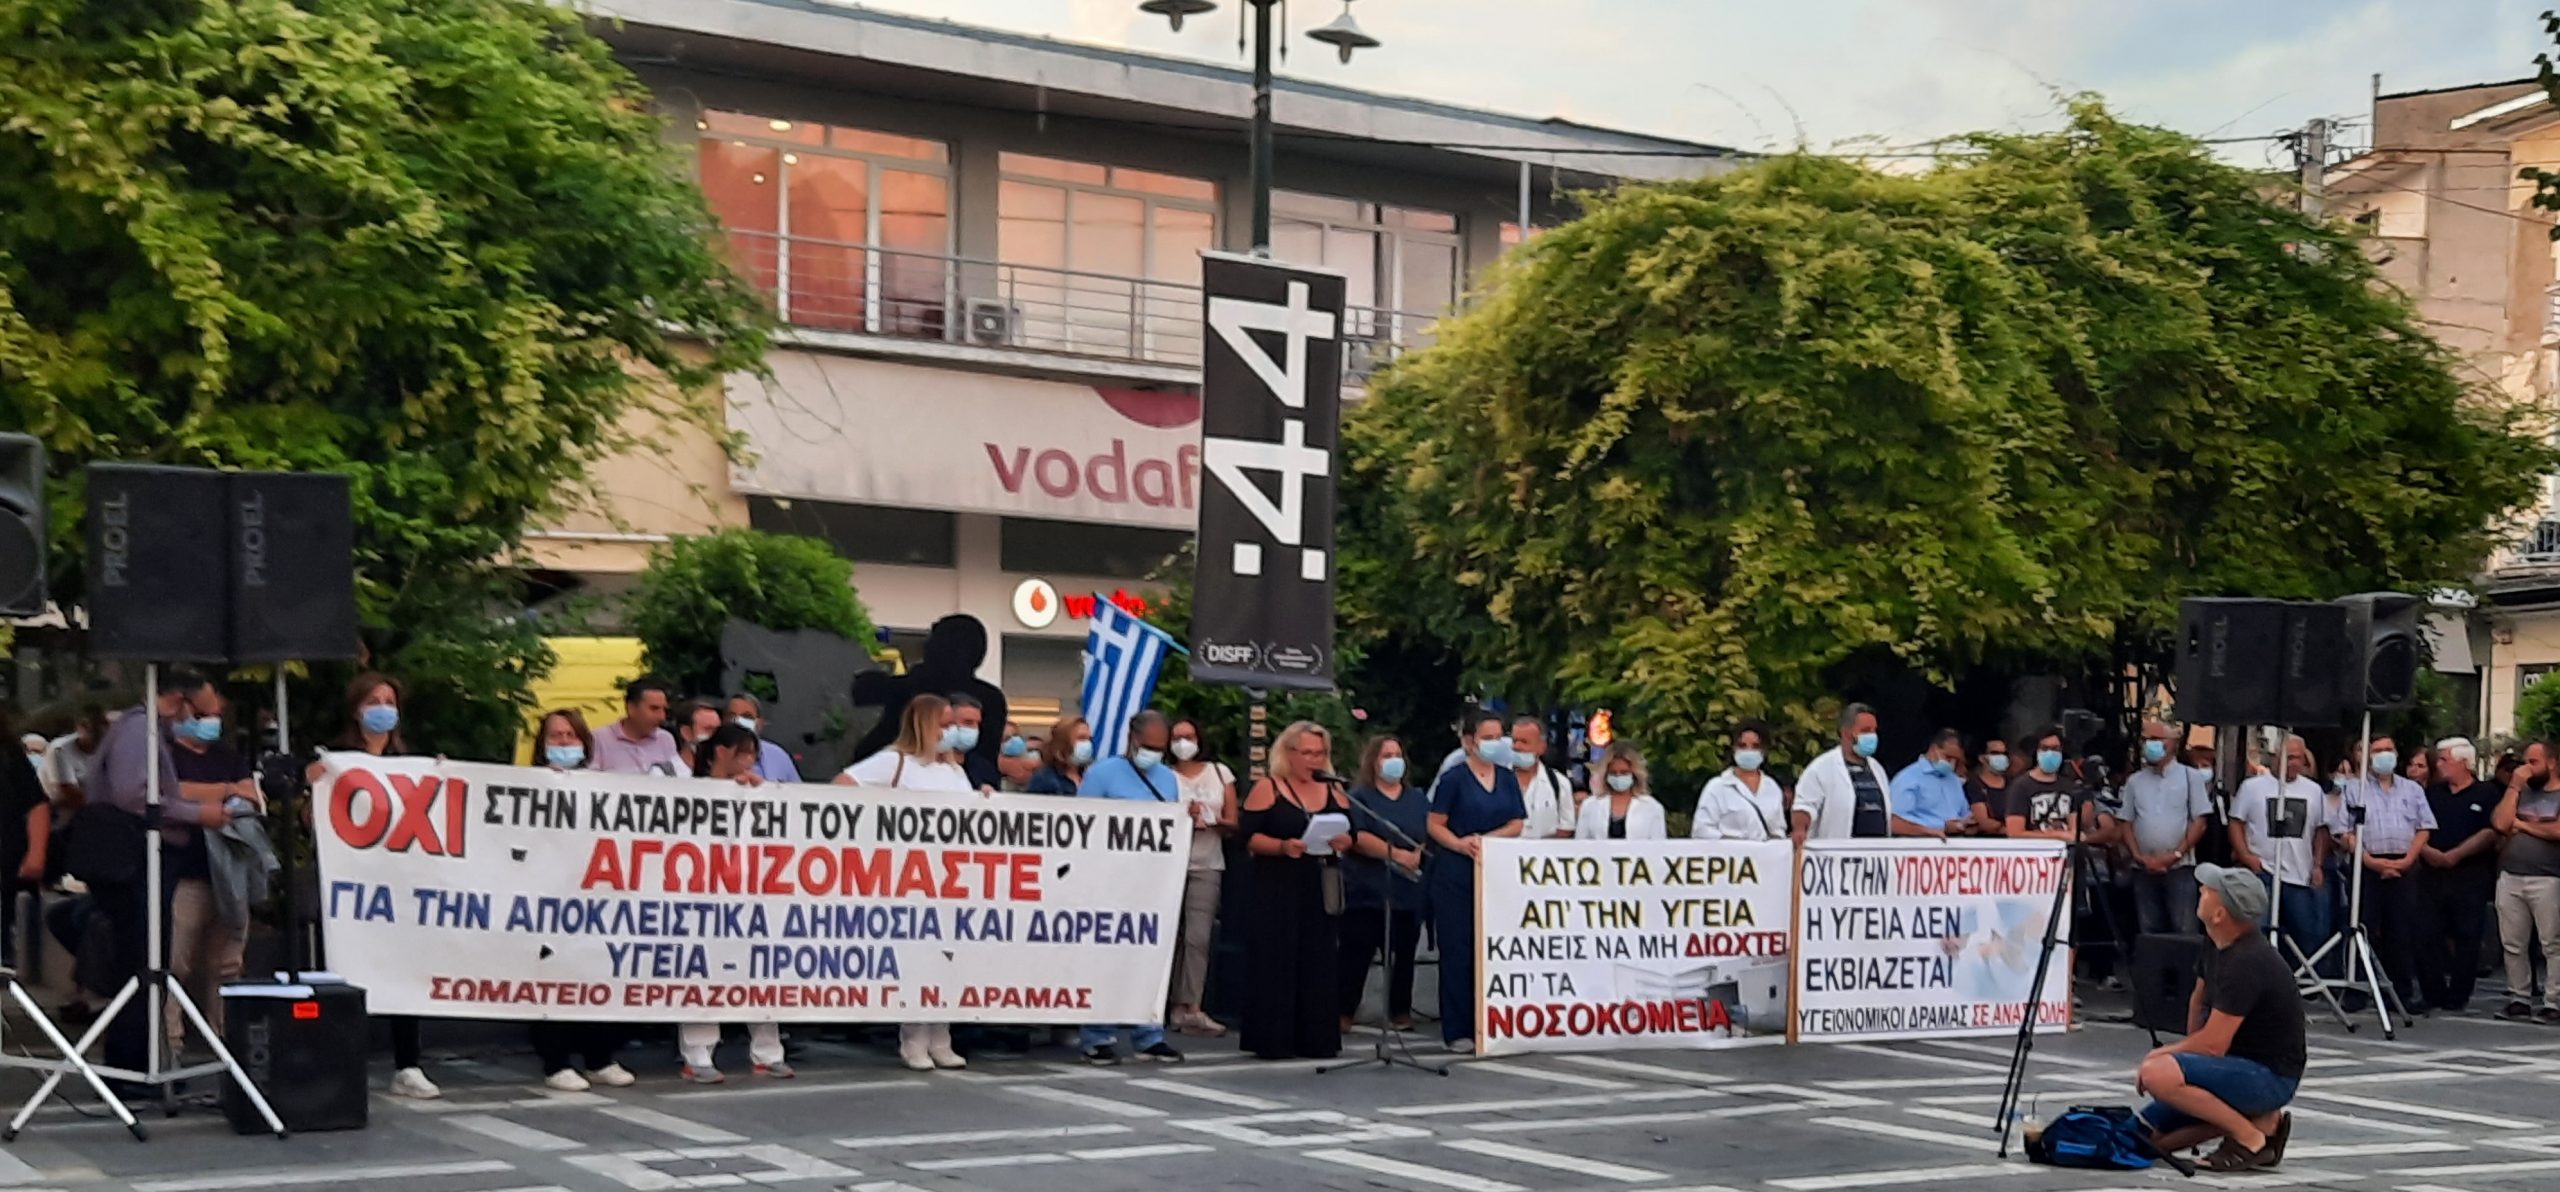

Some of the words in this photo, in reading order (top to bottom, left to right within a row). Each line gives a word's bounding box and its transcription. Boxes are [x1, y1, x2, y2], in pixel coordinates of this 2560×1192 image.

[103, 491, 129, 587] PROEL
[241, 489, 268, 586] PROEL
[329, 768, 469, 858] ΟΧΙ
[484, 784, 577, 830] ΣΤΗΝ
[590, 791, 787, 839] ΚΑΤΑΡΡΕΥΣΗ
[800, 801, 863, 840] ΤΟΥ
[876, 806, 1096, 850] ΝΟΣΟΚΟΜΕΙΟΥ
[1107, 815, 1174, 853] ΜΑΣ
[581, 838, 1043, 902] ΑΓΩΝΙΖΟΜΑΣΤΕ
[1519, 856, 1600, 886] ΚΑΤΩ
[1611, 856, 1653, 886] ΤΑ
[1663, 856, 1758, 886] ΧΕΡΙΑ
[1802, 856, 1834, 896] ΟΧΙ
[1840, 856, 1888, 896] ΣΤΗΝ
[1894, 855, 2070, 896] ΥΠΟΧΡΕΩΤΙΚΟΤΗΤ
[329, 881, 395, 923] ΓΙΑ
[413, 888, 491, 930] ΤΗΝ
[506, 895, 768, 939] ΑΠΟΚΛΕΙΣΤΙΚΑ
[783, 903, 941, 940] ΔΗΜΟΣΙΑ
[954, 907, 1014, 942] ΚΑΙ
[1027, 910, 1159, 945] ΔΩΡΕΑΝ
[1580, 899, 1641, 928] ΤΗΝ
[1661, 899, 1755, 927] ΥΓΕΙΑ
[1807, 907, 1823, 941] Η
[1831, 906, 1905, 941] ΥΓΕΙΑ
[1912, 906, 1961, 940] ΔΕΝ
[605, 942, 710, 978] ΥΓΕΙΑ
[750, 944, 900, 980] ΠΡΟΝΟΙΑ
[1488, 935, 1587, 961] ΚΑΝΕΙΣ
[1596, 935, 1631, 960] ΝΑ
[1639, 935, 1677, 959] ΜΗ
[429, 976, 611, 1006] ΣΩΜΑΤΕΙΟ
[623, 984, 868, 1007] ΕΡΓΑΖΟΜΕΝΩΝ
[880, 985, 907, 1009] Γ.
[920, 985, 948, 1009] Ν.
[958, 986, 1092, 1009] ΔΡΑΜΑΣ
[1542, 972, 1577, 997] ΤΑ
[1806, 956, 1953, 992] ΕΚΒΙΑΖΕΤΑΙ
[1487, 998, 1732, 1039] ΝΟΣΟΚΟΜΕΙΑ
[1909, 1004, 1968, 1029] ΔΡΑΜΑΣ
[1972, 1003, 1990, 1027] ΣΕ
